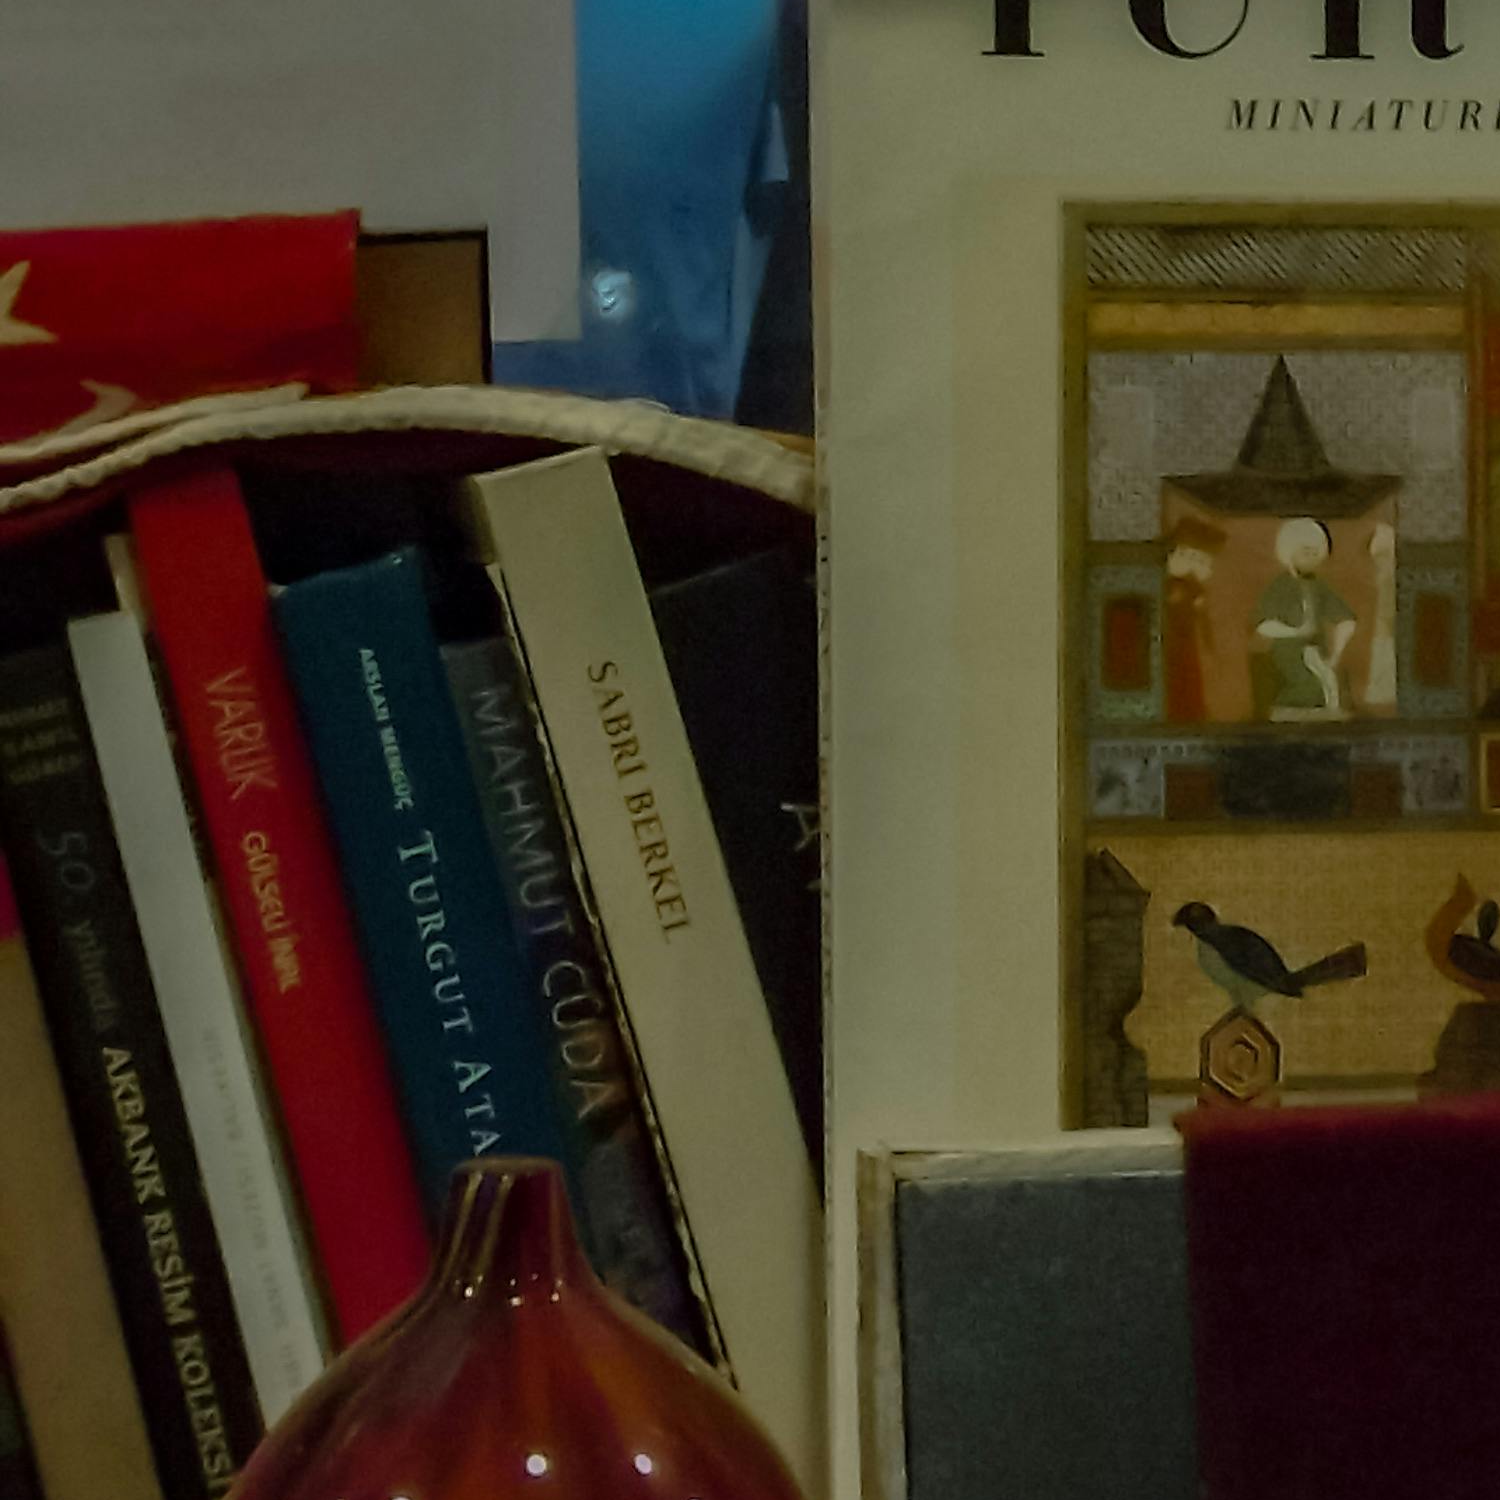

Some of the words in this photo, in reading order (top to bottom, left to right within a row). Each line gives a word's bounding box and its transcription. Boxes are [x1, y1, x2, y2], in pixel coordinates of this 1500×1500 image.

[469, 683, 580, 940] MAHMUT
[622, 788, 696, 946] BERKEL
[399, 829, 474, 1034] TURGUT
[452, 1058, 502, 1157] ATA
[103, 1045, 167, 1205] AKBANK
